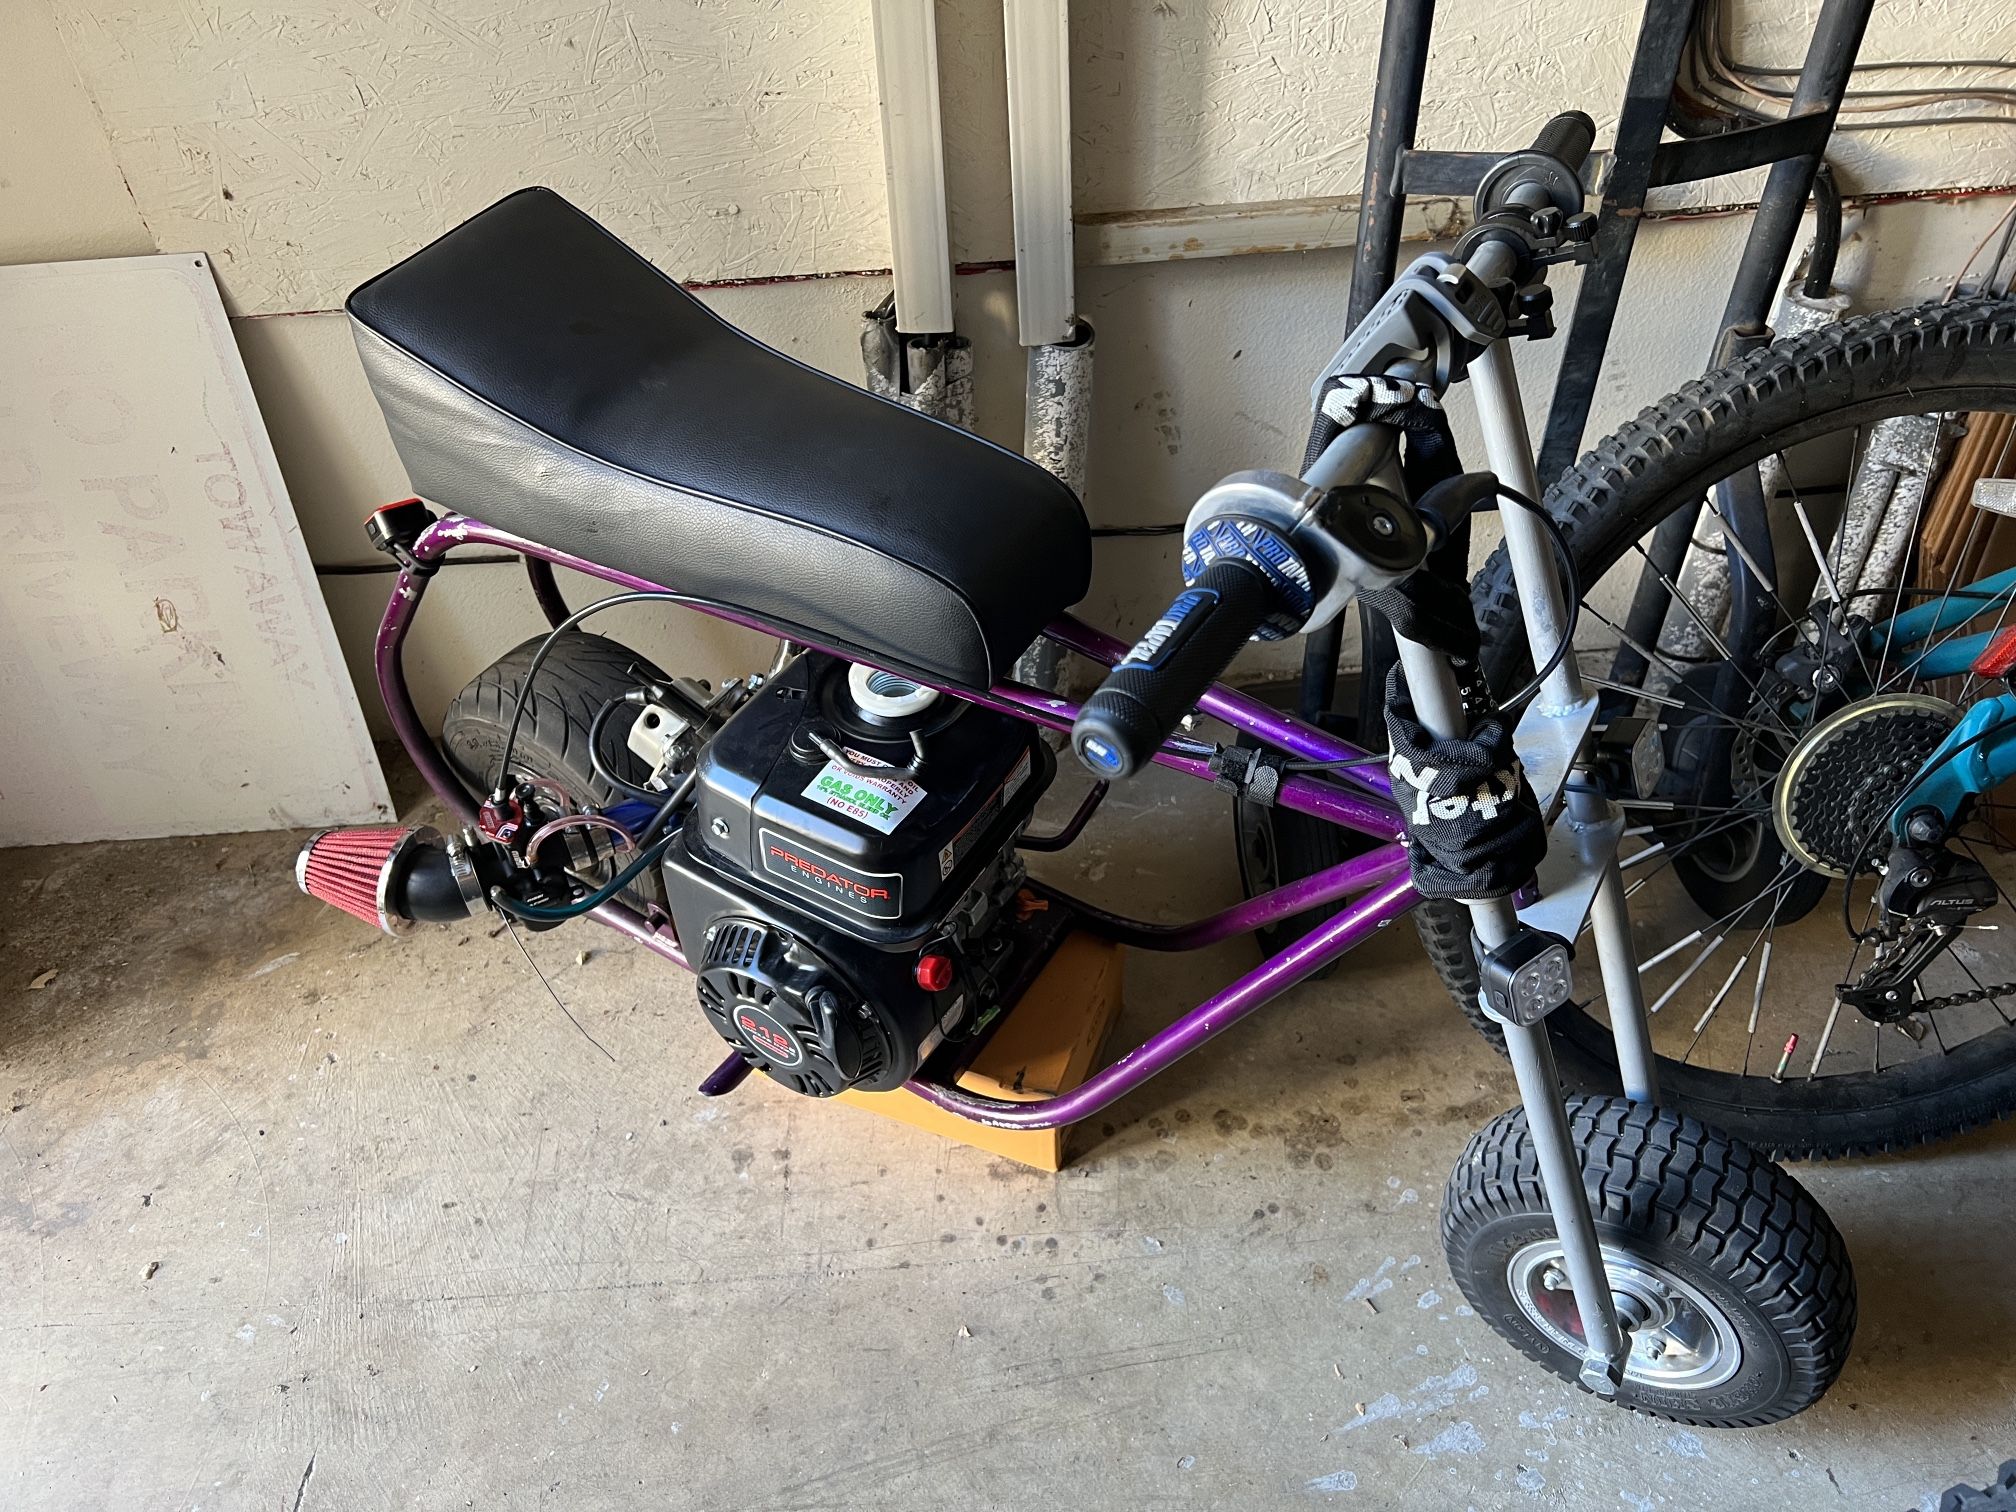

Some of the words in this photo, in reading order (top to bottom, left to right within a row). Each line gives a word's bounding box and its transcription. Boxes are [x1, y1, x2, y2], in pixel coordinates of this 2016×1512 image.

[195, 442, 267, 555] TOW
[234, 565, 316, 690] AWAY
[845, 749, 860, 758] YOU
[860, 754, 881, 766] MUST
[820, 775, 854, 794] GAS
[854, 789, 899, 815] ONLY
[866, 778, 908, 805] WARRANTY
[898, 782, 914, 795] AND
[907, 780, 920, 793] OIL
[826, 796, 845, 809] (NO
[846, 805, 869, 819] E85)
[770, 845, 890, 900] PREDATOR
[790, 864, 868, 904] ENGINES
[1930, 898, 1975, 906] ALTUS
